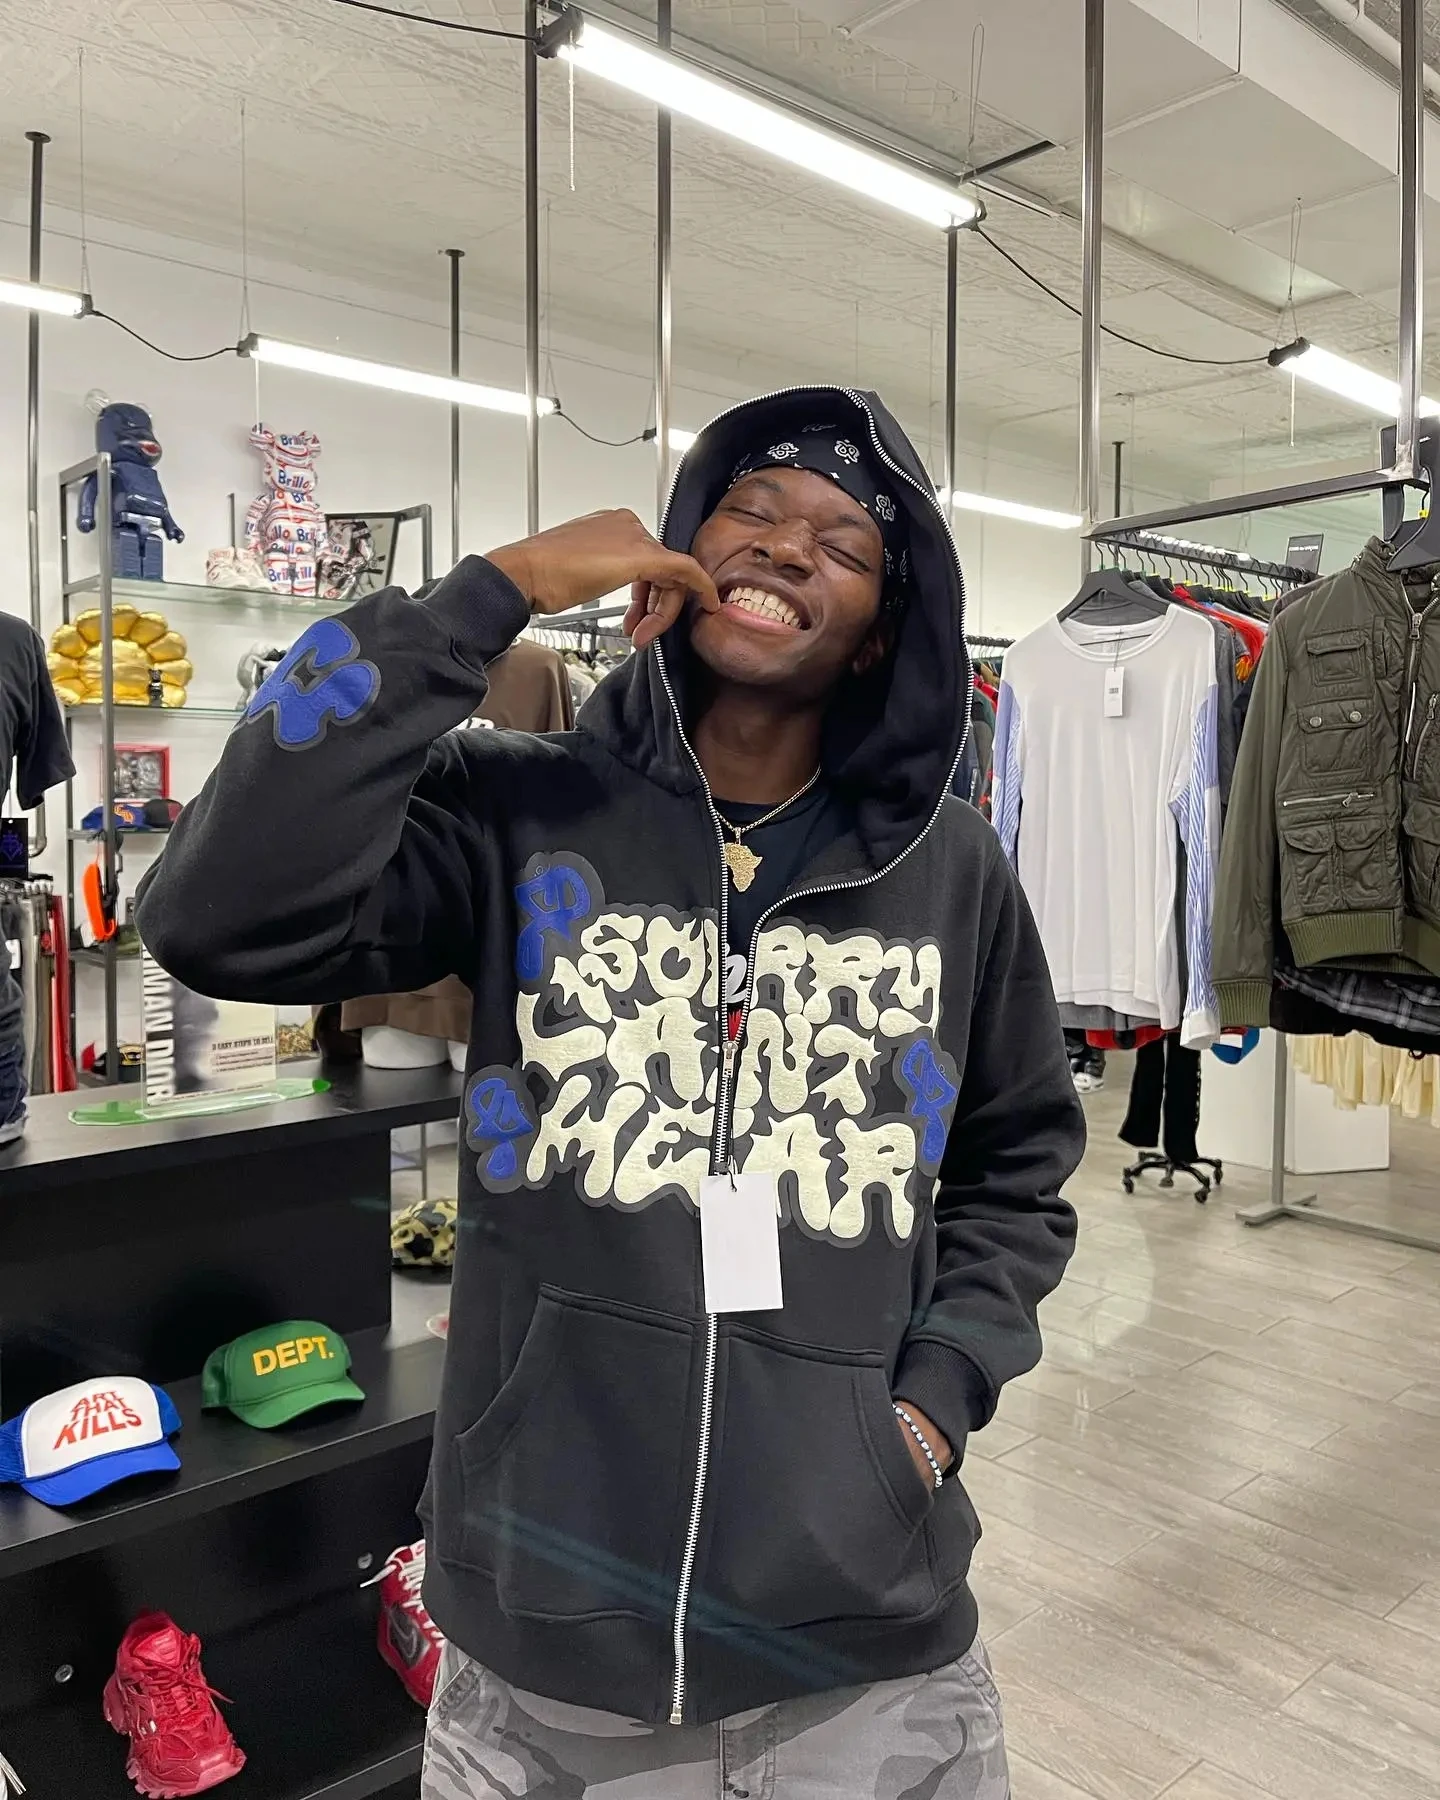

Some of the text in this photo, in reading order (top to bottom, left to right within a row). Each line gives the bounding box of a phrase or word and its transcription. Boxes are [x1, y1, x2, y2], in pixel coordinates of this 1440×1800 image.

[278, 469, 310, 489] Brillo
[145, 1038, 177, 1107] DIOR
[252, 1335, 335, 1377] DEPT.
[71, 1391, 117, 1413] ART
[71, 1397, 128, 1421] THAT
[53, 1408, 142, 1451] KILLS
